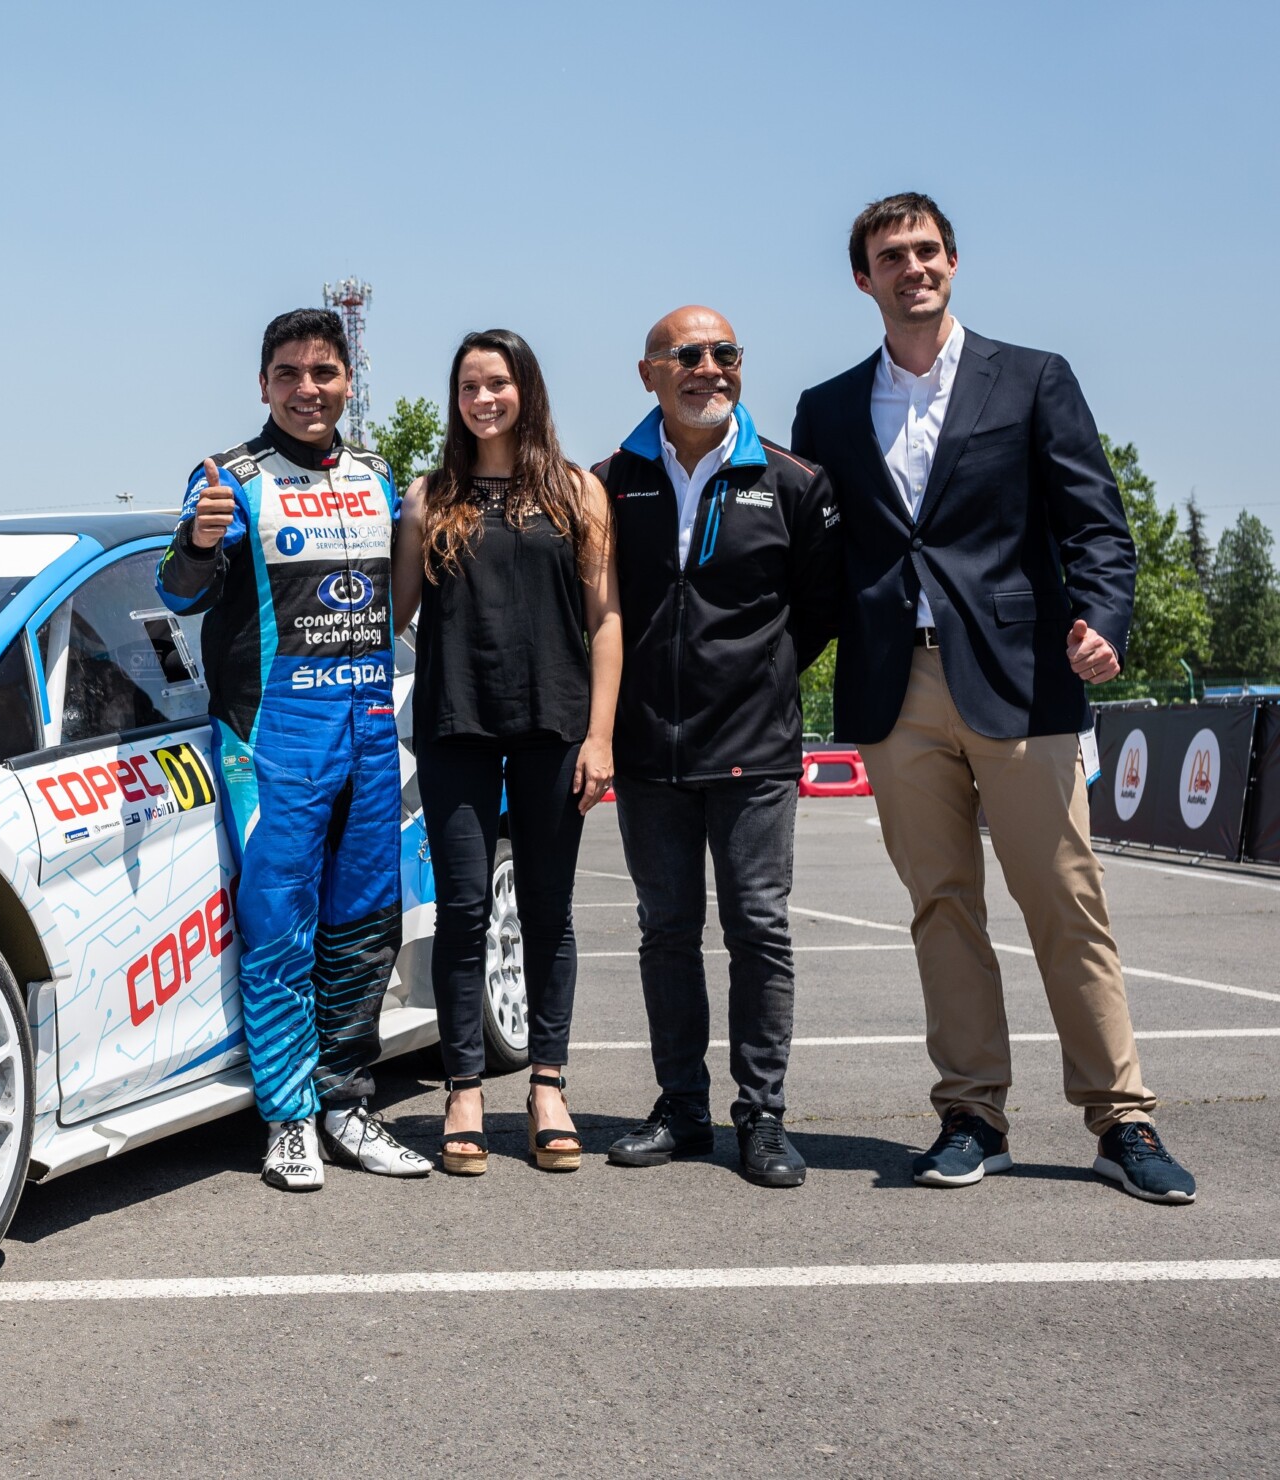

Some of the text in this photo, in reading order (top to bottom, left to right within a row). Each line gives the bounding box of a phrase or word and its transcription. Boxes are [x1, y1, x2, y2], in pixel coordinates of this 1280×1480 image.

[236, 462, 255, 475] OMP
[274, 475, 310, 486] Mobil 1
[736, 488, 774, 502] WRC
[279, 490, 377, 518] COPEC
[304, 527, 358, 540] PRIMUS
[316, 542, 350, 550] SERVICIOS
[368, 606, 387, 624] belt
[305, 625, 382, 645] technology
[292, 664, 387, 690] ŠKODA
[156, 744, 212, 811] 01
[36, 754, 166, 822] COPEC
[1120, 789, 1136, 799] AutoMac
[1187, 794, 1207, 806] AutoMac
[144, 805, 167, 822] Mobil
[274, 1164, 312, 1175] OMP
